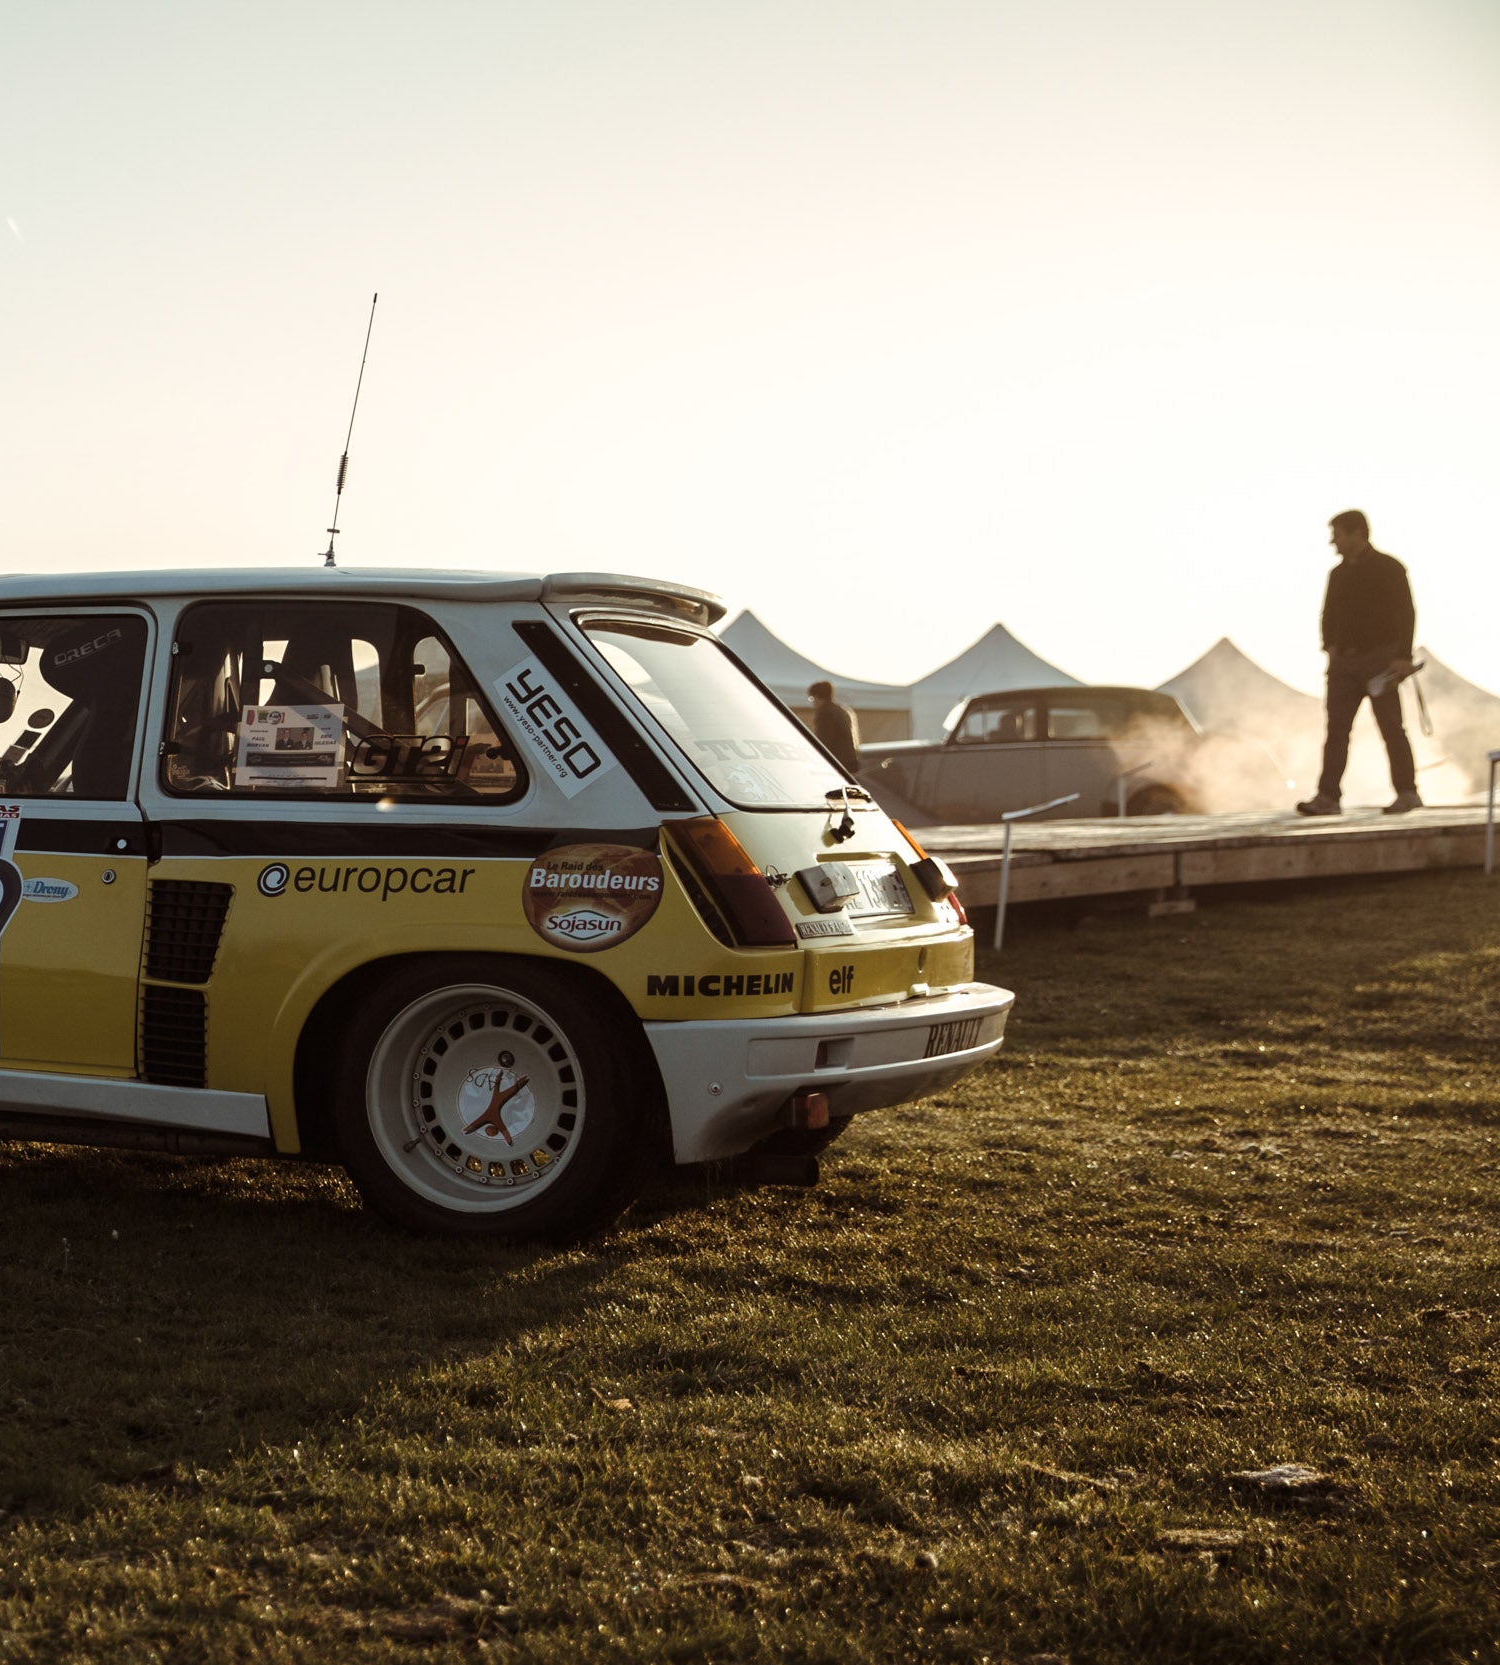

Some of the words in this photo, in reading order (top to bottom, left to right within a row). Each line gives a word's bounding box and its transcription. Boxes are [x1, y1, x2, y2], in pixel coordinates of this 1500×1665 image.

[503, 696, 568, 778] www.yeso-partner.org
[505, 668, 601, 779] YESO
[530, 868, 660, 891] Baroudeurs
[561, 862, 583, 871] Raid
[546, 915, 622, 933] Sojasun
[646, 972, 794, 997] MICHELIN
[828, 965, 854, 995] elf
[923, 1016, 984, 1058] RENAULT
